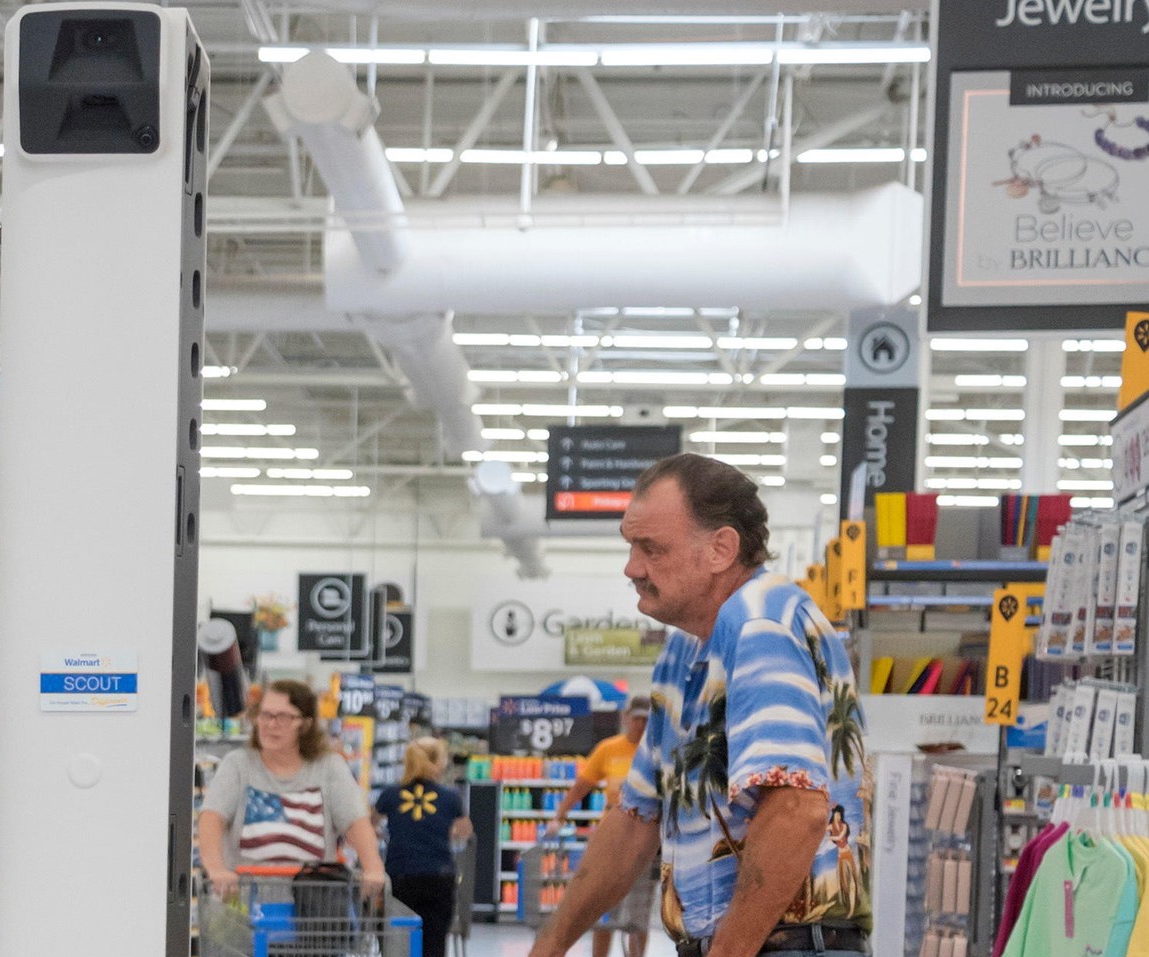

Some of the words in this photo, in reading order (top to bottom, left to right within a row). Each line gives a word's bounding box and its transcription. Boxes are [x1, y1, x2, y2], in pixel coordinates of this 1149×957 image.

[1026, 82, 1134, 98] INTRODUCING
[1015, 212, 1134, 243] Believe
[866, 401, 895, 488] Home
[64, 658, 101, 667] Walmart
[63, 676, 122, 691] SCOUT
[995, 666, 1010, 688] B
[987, 697, 1013, 719] 24
